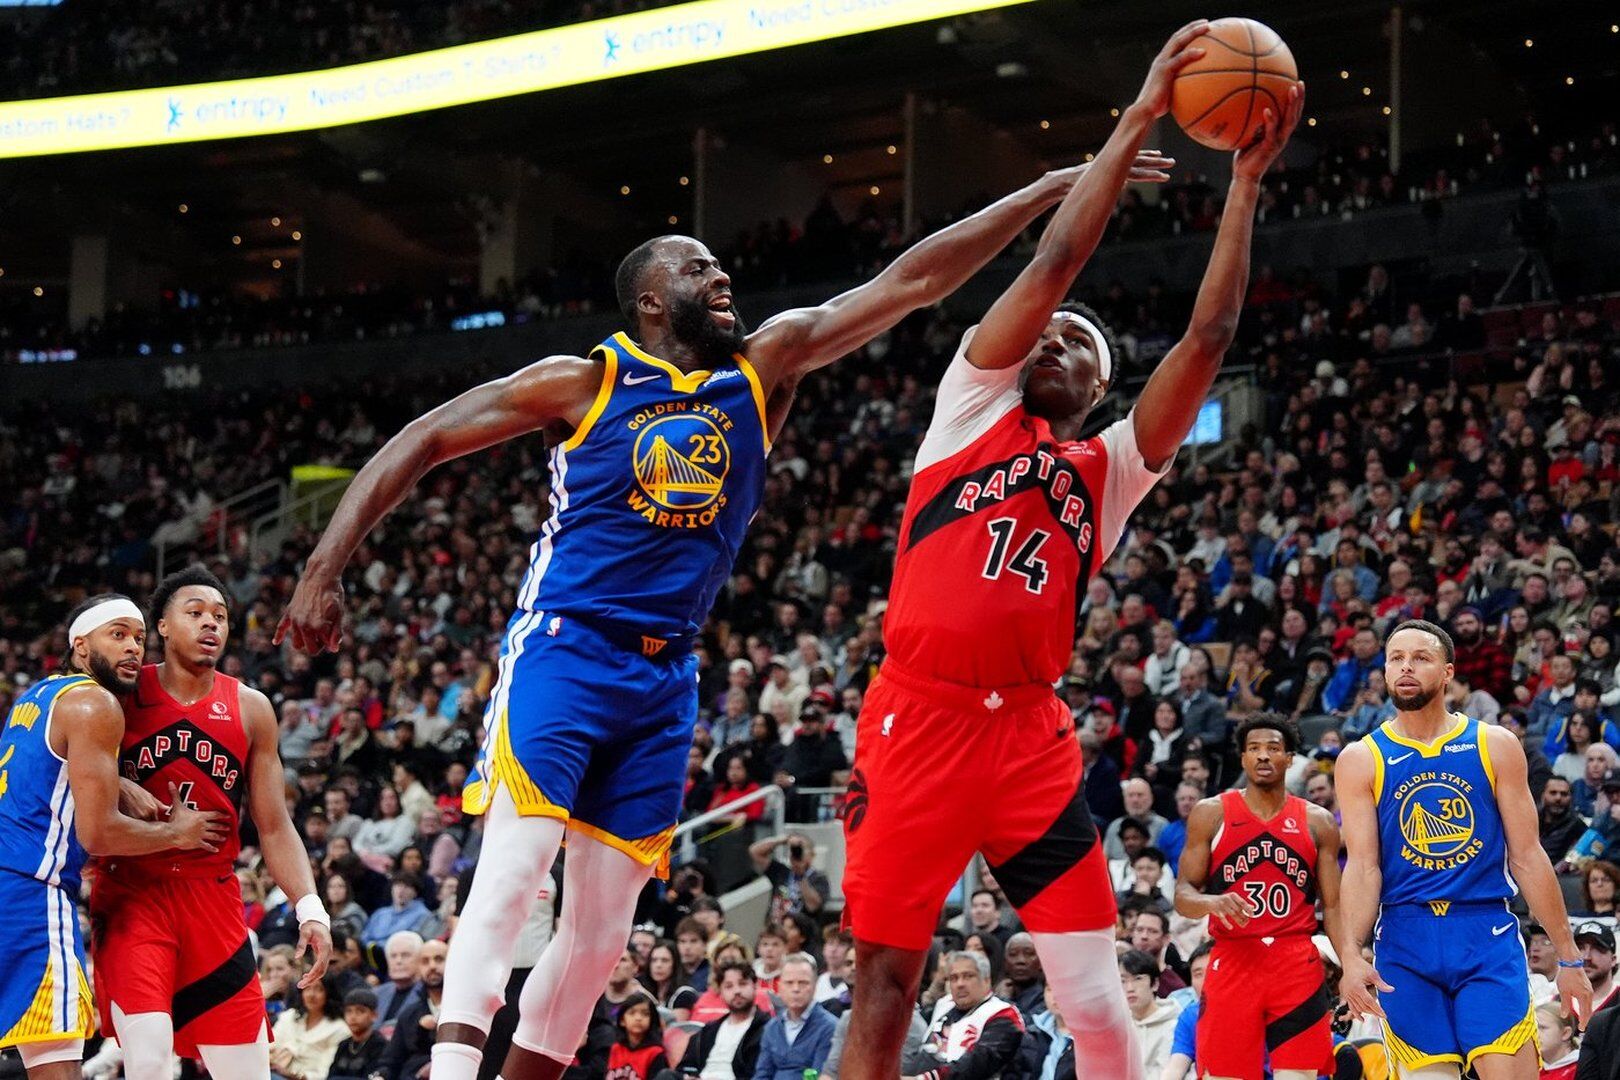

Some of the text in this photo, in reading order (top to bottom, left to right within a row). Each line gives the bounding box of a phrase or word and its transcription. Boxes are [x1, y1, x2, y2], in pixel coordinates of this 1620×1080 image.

[631, 19, 727, 52] entripy
[195, 96, 289, 123] entripy
[0, 116, 58, 137] stom
[627, 402, 734, 431] GOLDEN STATE
[689, 434, 722, 464] 23
[626, 489, 727, 529] WARRIORS
[955, 450, 1092, 554] RAPTORS
[981, 516, 1051, 595] 14
[124, 730, 238, 790] RAPTORS
[1394, 772, 1473, 800] GOLDEN STATE
[1437, 797, 1467, 820] 30
[1223, 841, 1307, 887] RAPTORS
[1400, 838, 1484, 871] WARRIORS
[1242, 881, 1291, 918] 30
